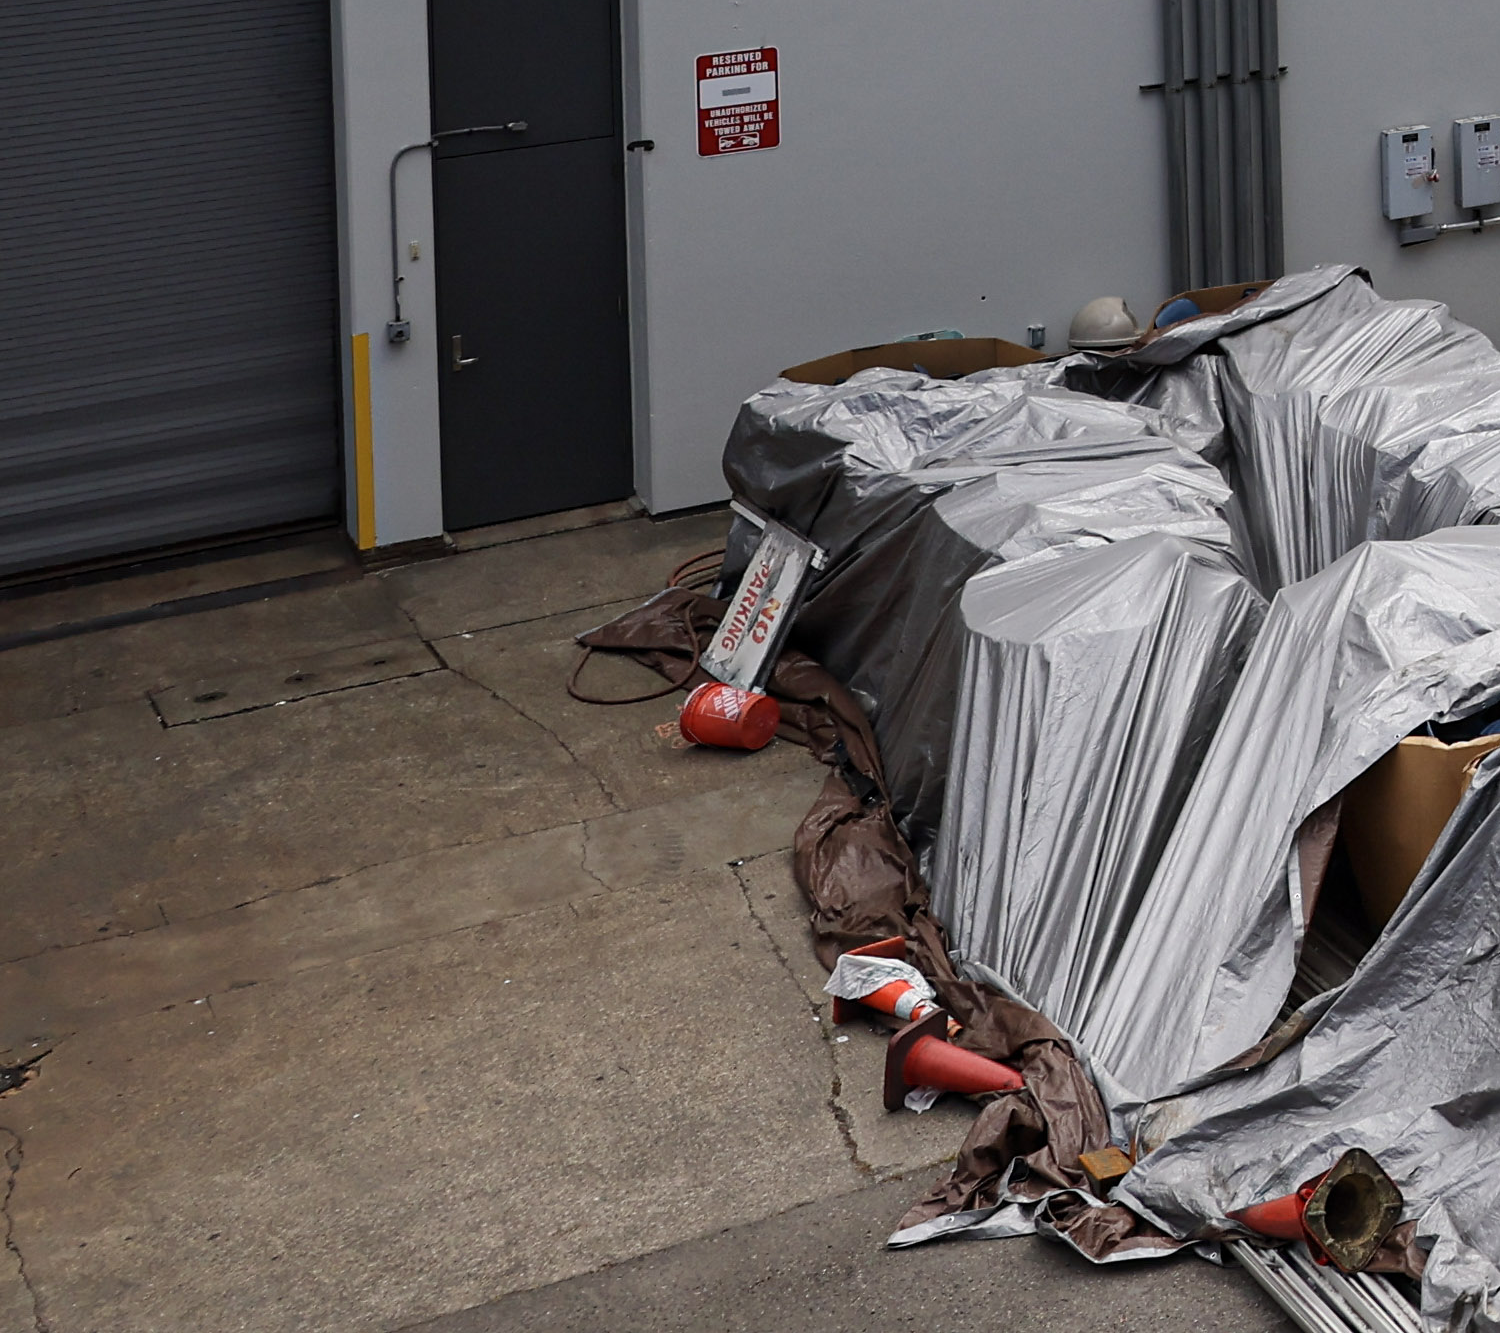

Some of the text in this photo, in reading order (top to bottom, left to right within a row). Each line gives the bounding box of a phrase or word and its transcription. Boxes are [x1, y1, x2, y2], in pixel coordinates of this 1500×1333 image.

[712, 52, 761, 65] RESERVED
[706, 62, 768, 77] PARKING FOR
[710, 104, 767, 117] UNAUTHORIZED
[705, 112, 773, 128] VEHICLES WILL BE
[714, 123, 764, 136] TOWED AWAY
[721, 560, 770, 652] PARKING
[752, 597, 781, 645] NO
